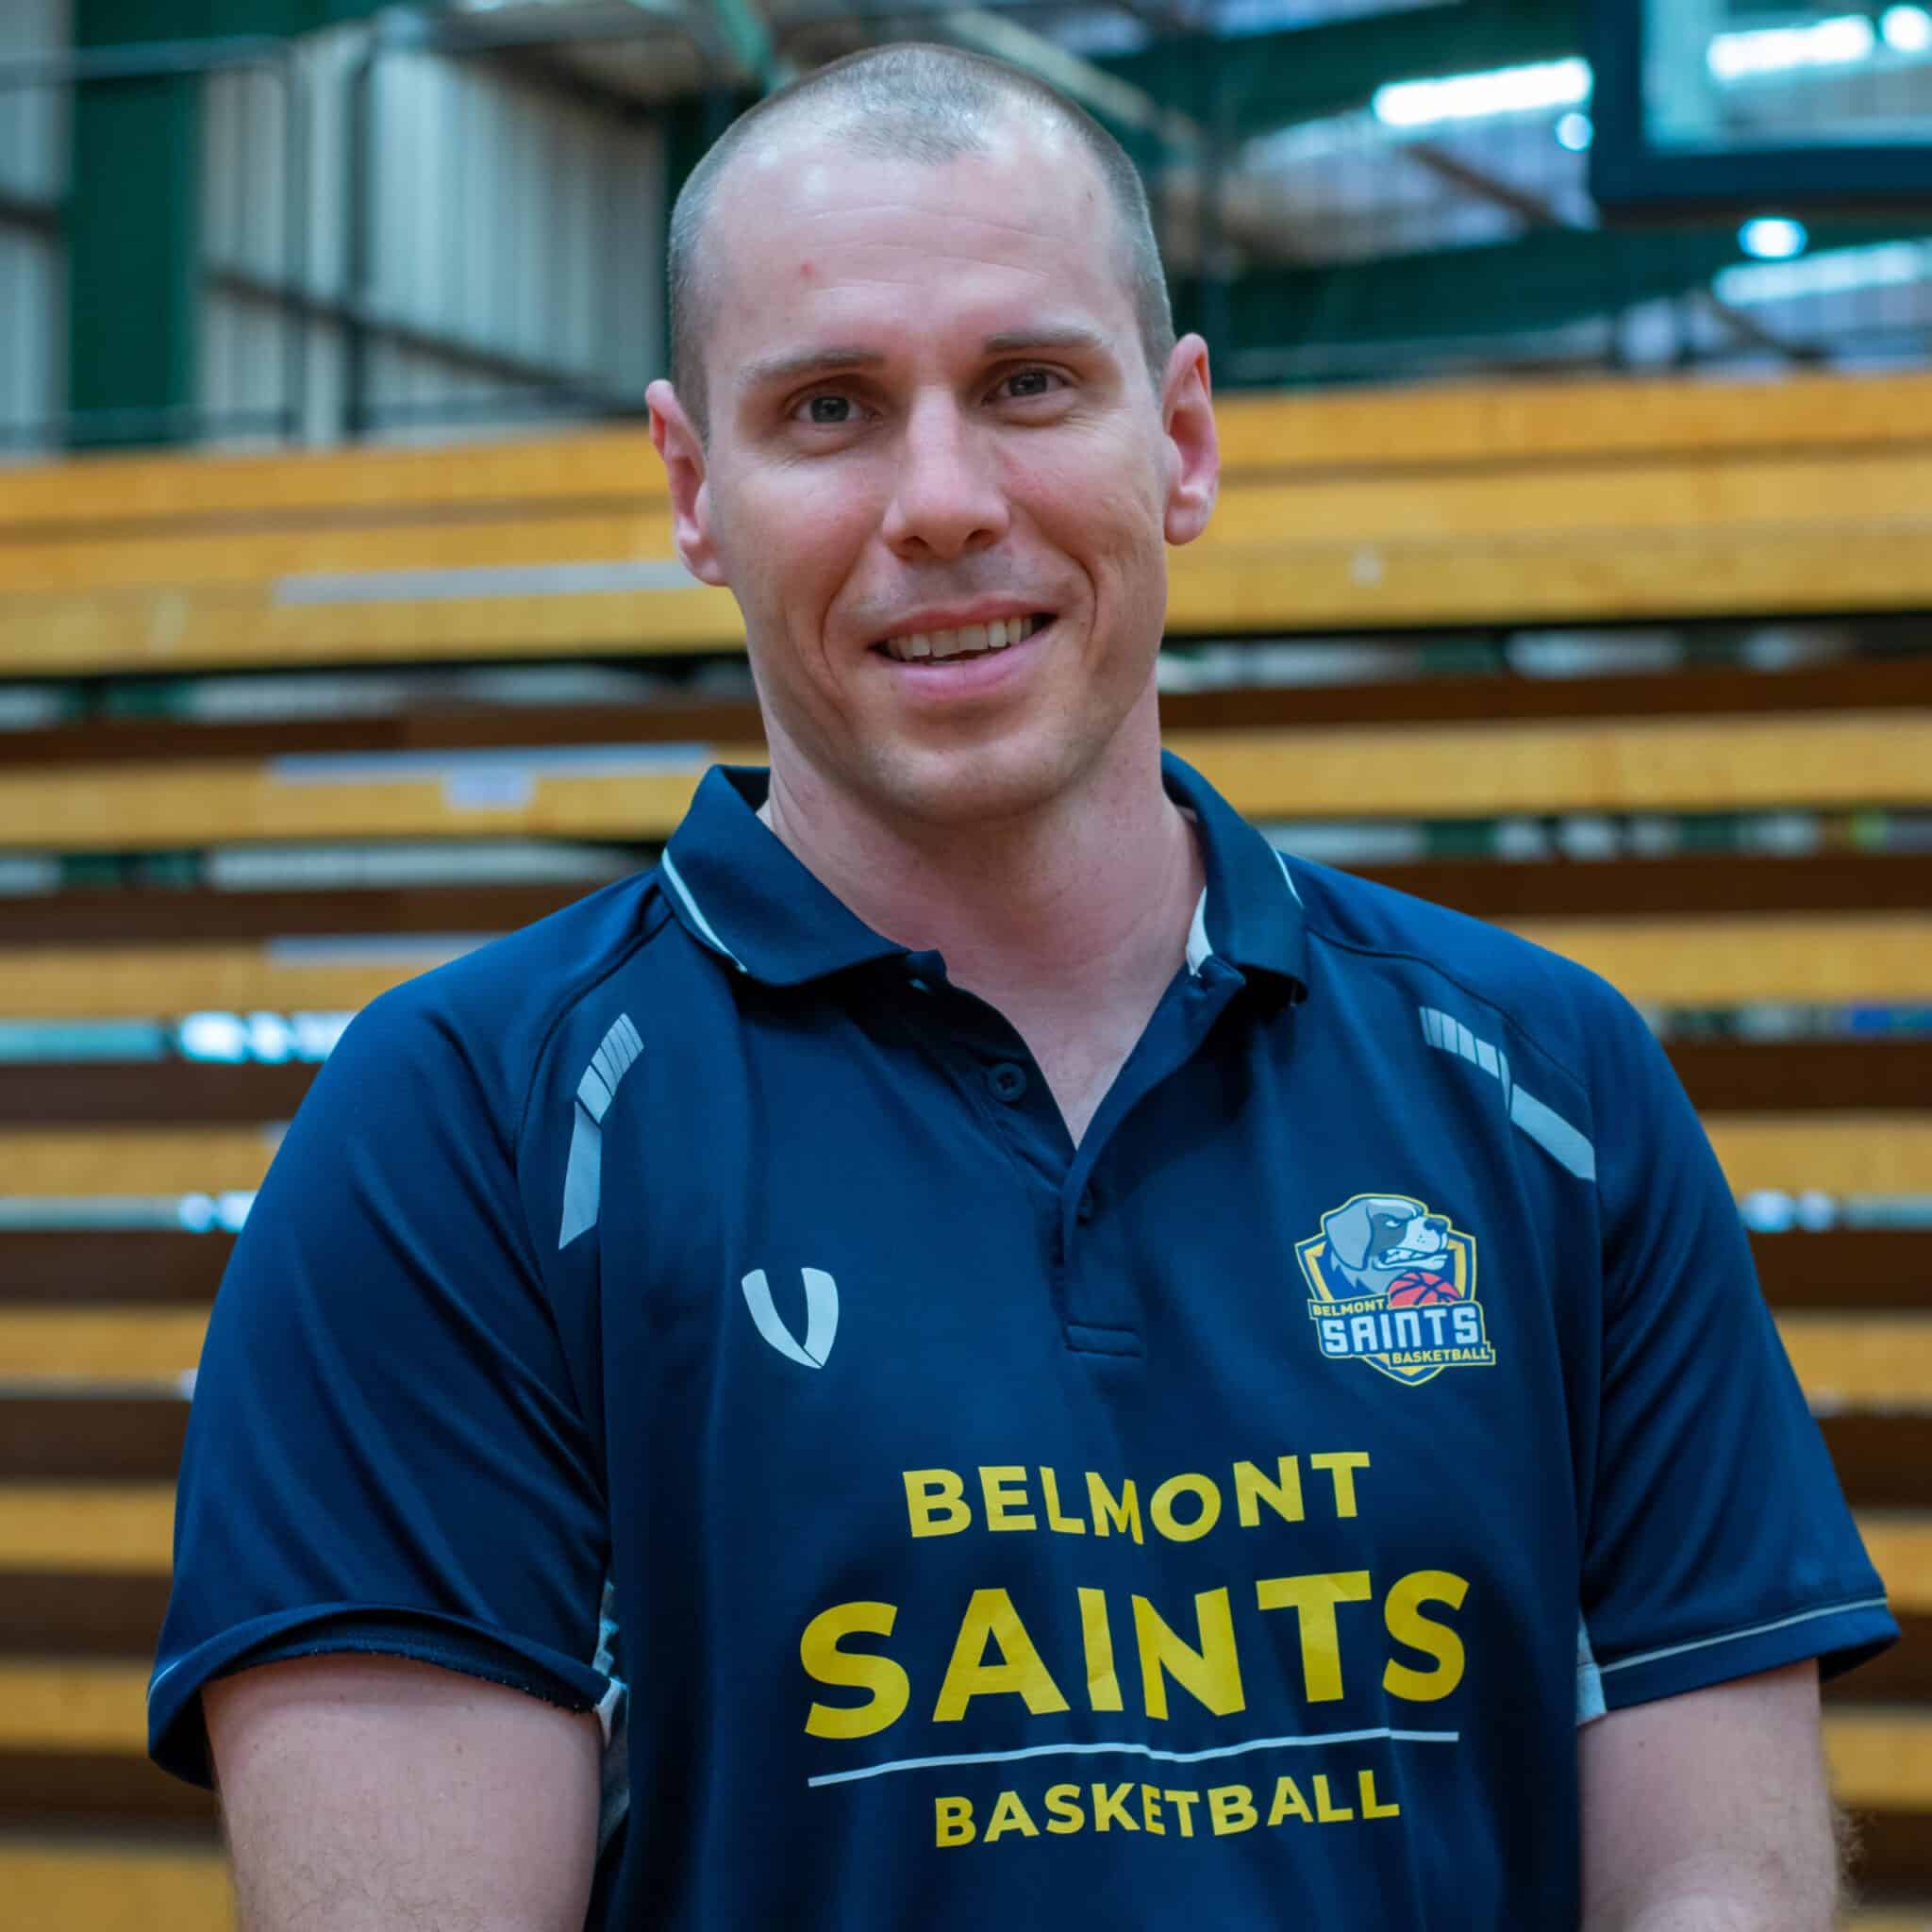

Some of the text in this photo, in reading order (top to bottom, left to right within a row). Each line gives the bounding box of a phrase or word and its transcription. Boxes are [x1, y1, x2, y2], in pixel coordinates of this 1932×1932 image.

[1312, 1298, 1386, 1316] BELMONT
[1321, 1306, 1479, 1354] SAINTS
[1391, 1347, 1490, 1364] BASKETBALL
[902, 1452, 1371, 1545] BELMONT
[800, 1570, 1471, 1740] SAINTS
[935, 1770, 1400, 1848] BASKETBALL
